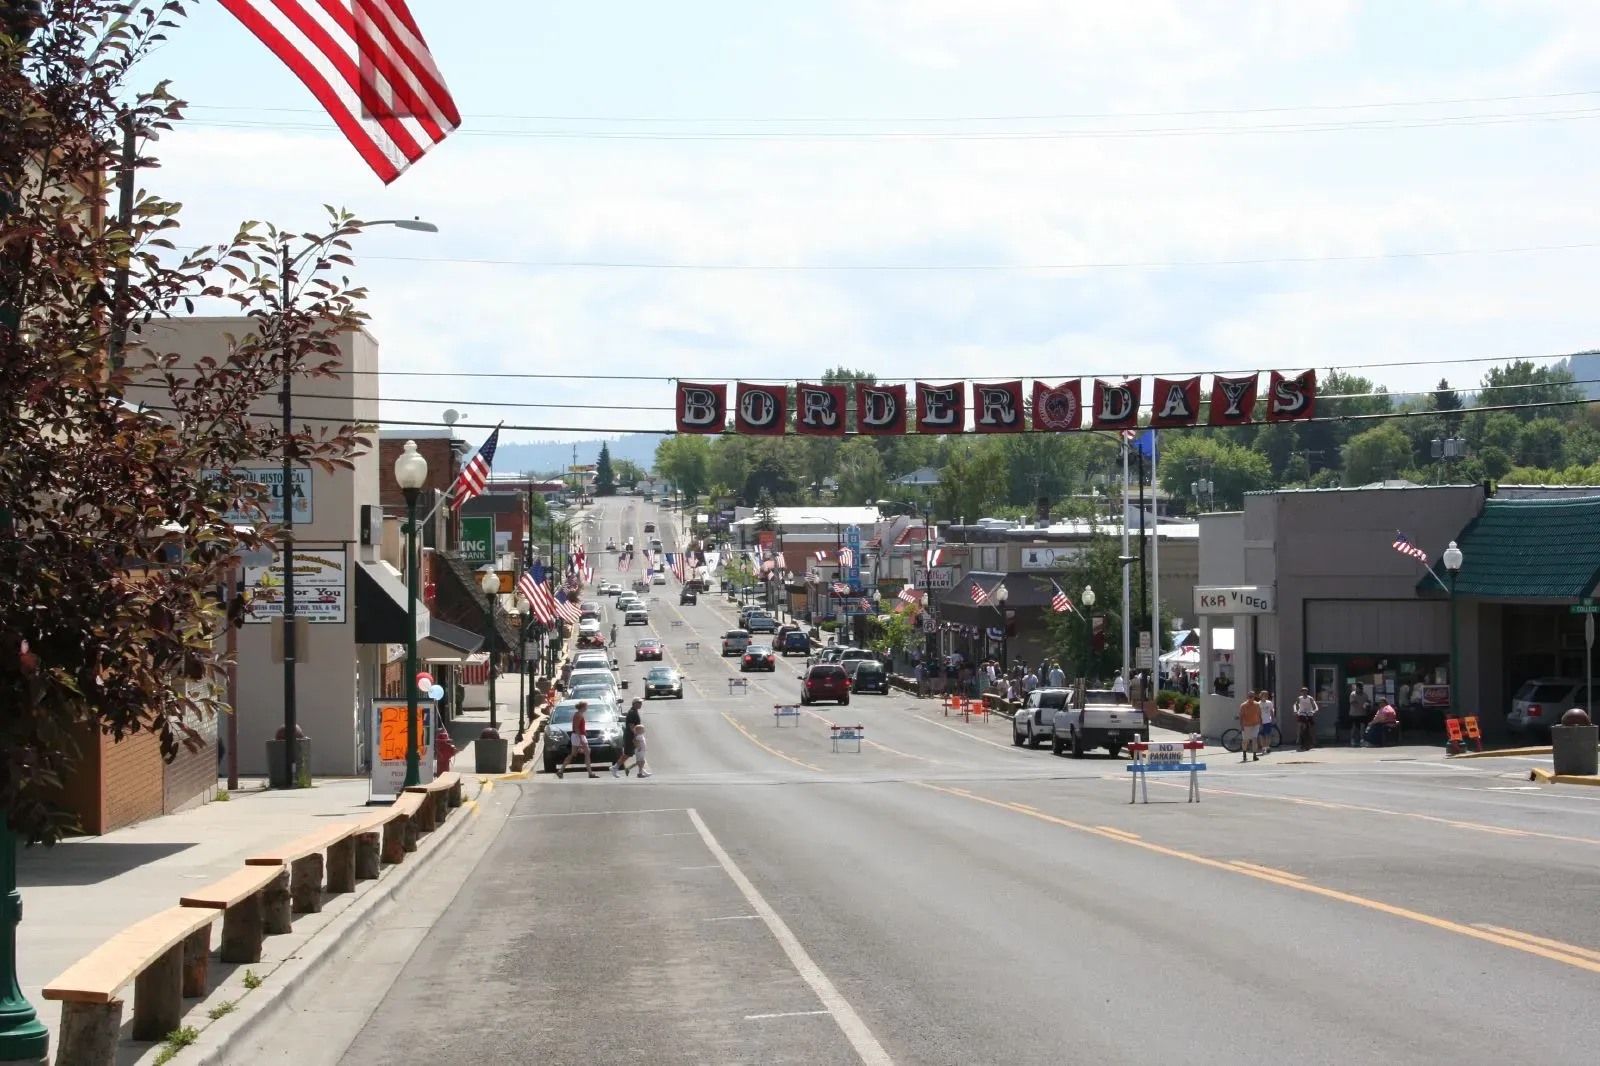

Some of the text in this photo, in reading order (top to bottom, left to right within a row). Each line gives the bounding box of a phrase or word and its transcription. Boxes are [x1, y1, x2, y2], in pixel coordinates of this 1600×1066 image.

[681, 387, 1017, 427] BORDER
[1098, 379, 1305, 420] DAYS
[260, 473, 305, 484] HISTOCAL
[461, 541, 486, 551] ING
[315, 588, 341, 597] You
[1201, 591, 1267, 610] K&R VIDEO
[1159, 744, 1174, 752] NO
[1150, 752, 1183, 760] PARKING
